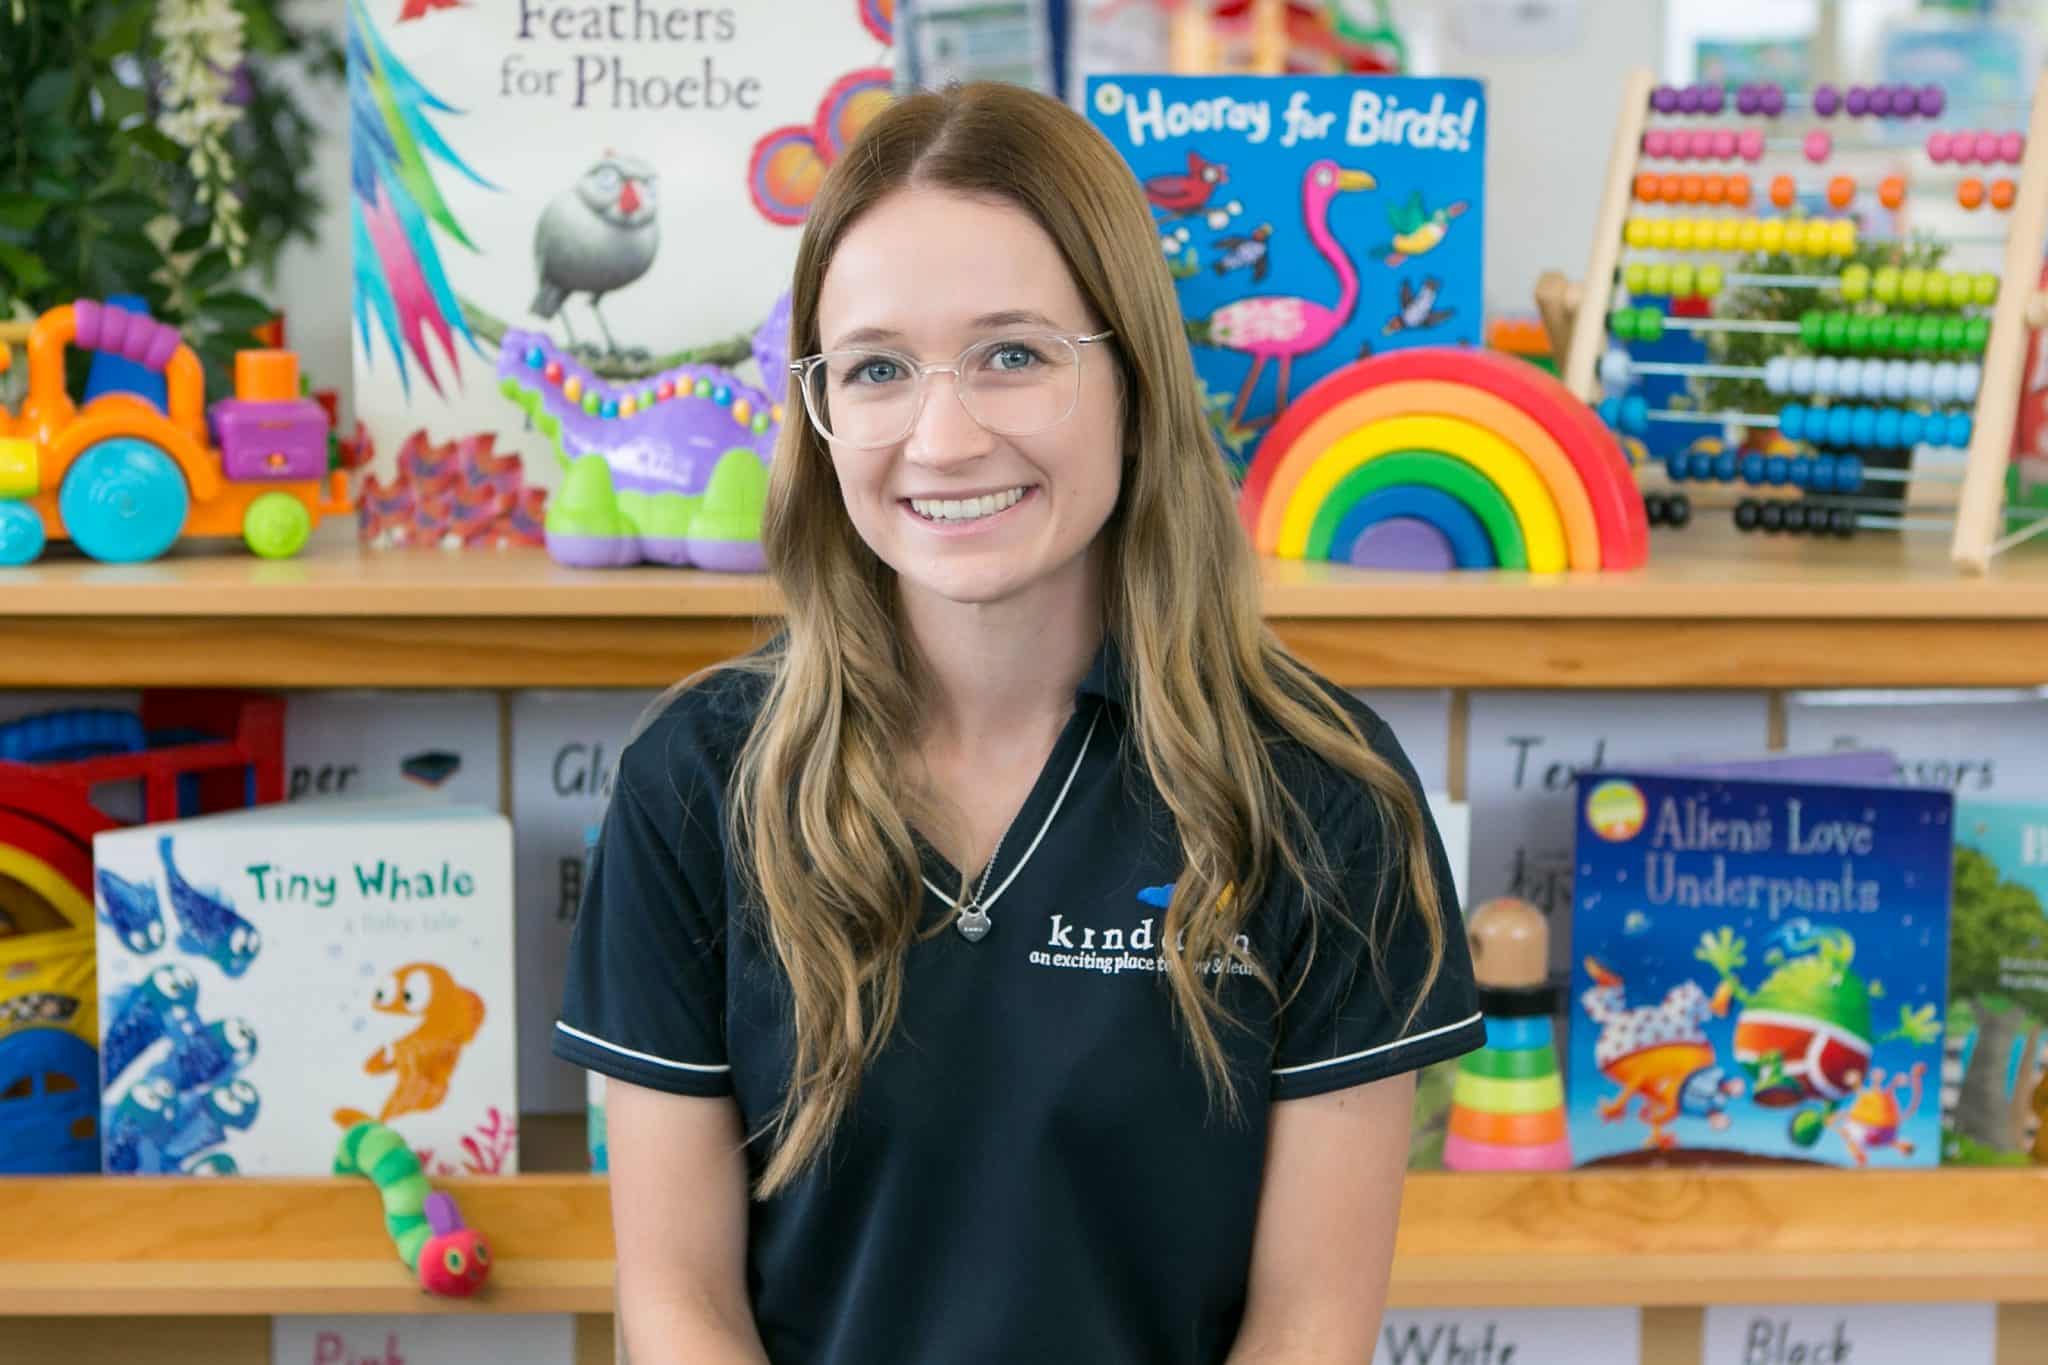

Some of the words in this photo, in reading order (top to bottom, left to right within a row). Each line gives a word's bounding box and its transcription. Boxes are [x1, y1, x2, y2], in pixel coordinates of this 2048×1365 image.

[516, 0, 737, 41] Feathers
[499, 54, 561, 97] for
[572, 54, 762, 109] Phoebe
[1125, 88, 1271, 147] Hooray
[1280, 91, 1337, 149] for
[1345, 89, 1478, 151] Birds!
[1652, 797, 1773, 851] Aliens
[1787, 799, 1874, 856] Love
[247, 864, 337, 908] Tiny
[353, 860, 475, 902] Whale
[1646, 852, 1881, 921] Underpants
[1029, 950, 1051, 967] an
[1053, 951, 1113, 974] exciting
[1113, 951, 1155, 974] place
